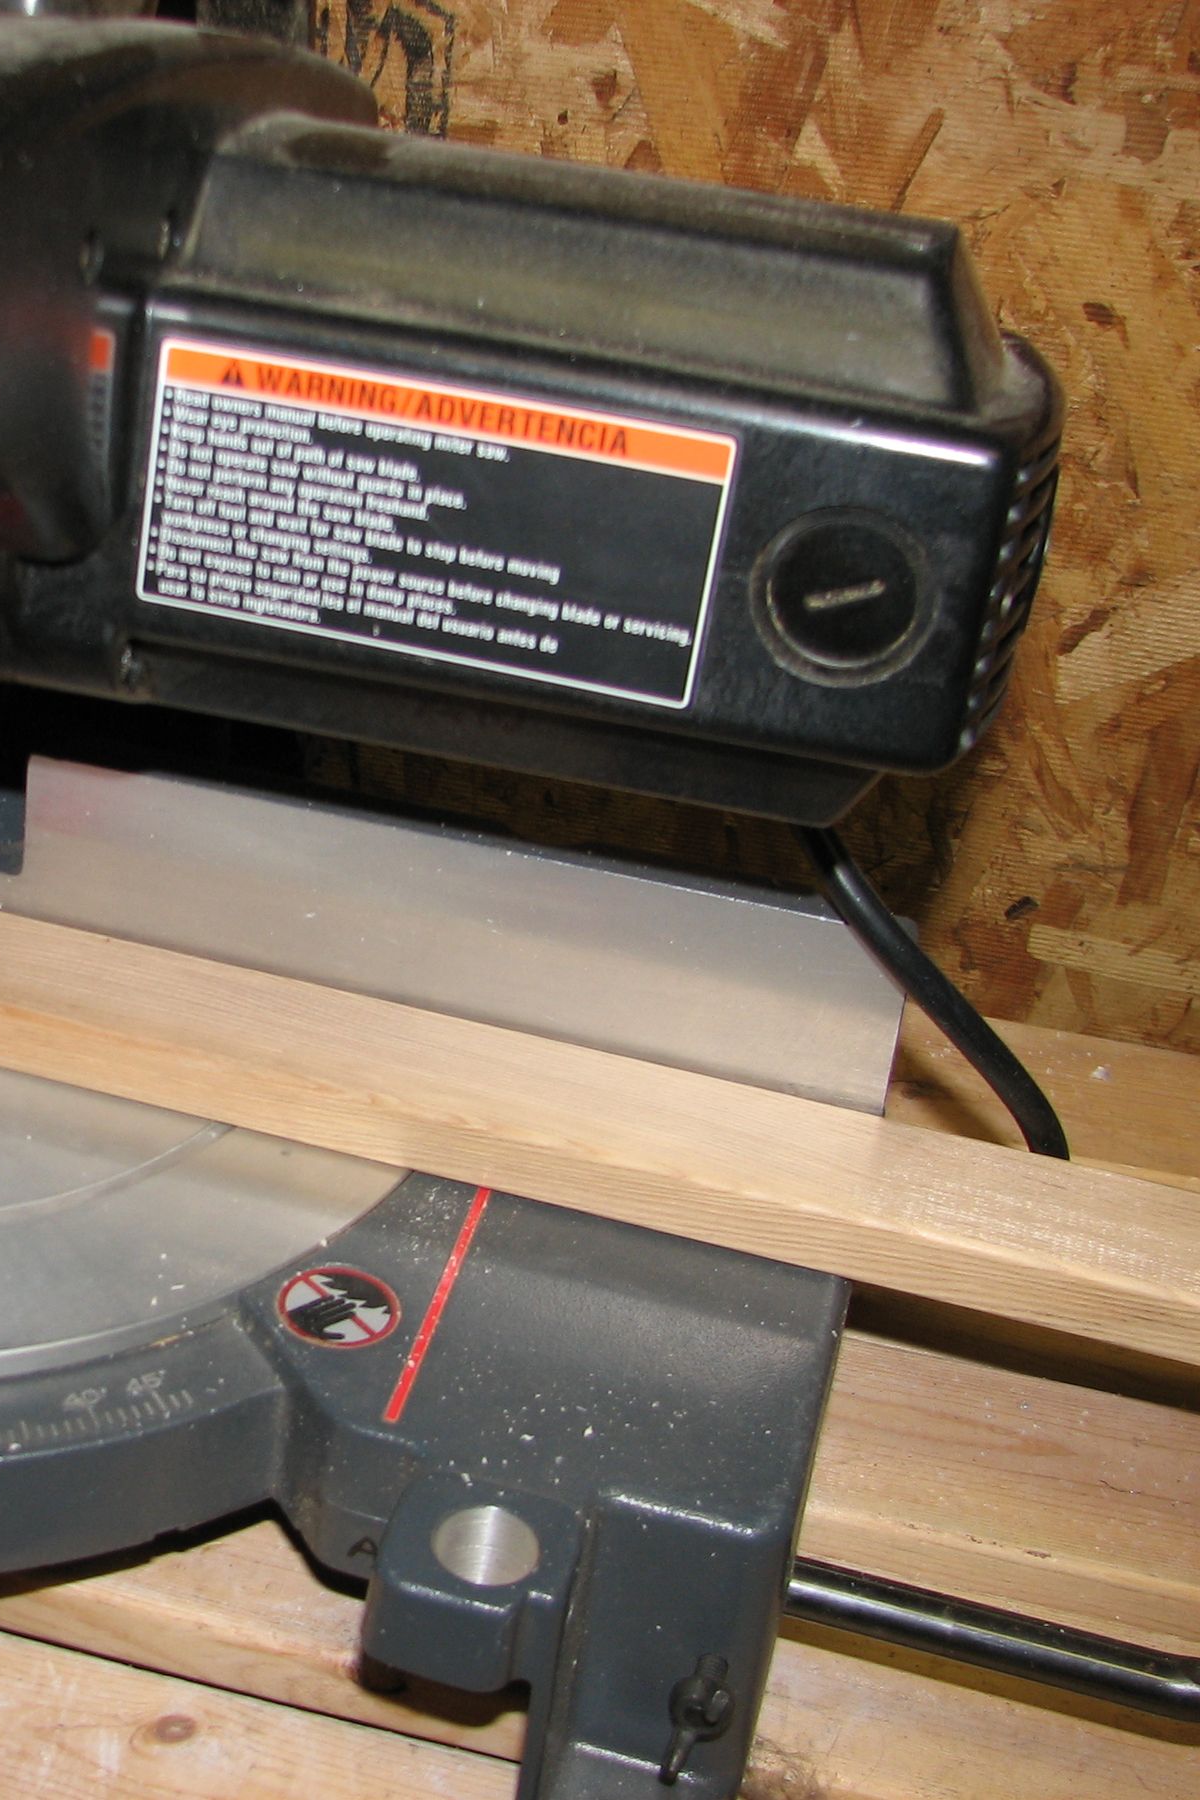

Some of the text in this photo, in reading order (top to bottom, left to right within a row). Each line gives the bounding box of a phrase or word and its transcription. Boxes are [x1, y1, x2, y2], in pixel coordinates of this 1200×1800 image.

[172, 405, 208, 426] Wear
[210, 414, 236, 433] eye
[173, 388, 208, 408] Read
[263, 404, 315, 427] manual
[317, 413, 362, 435] before
[364, 421, 432, 451] operating
[168, 438, 188, 459] Do
[189, 442, 213, 463] not
[214, 447, 268, 475] operate
[269, 459, 300, 479] saw
[301, 462, 355, 489] without
[356, 472, 404, 500] guards
[406, 481, 423, 501] in
[170, 421, 205, 446] Keep
[206, 428, 248, 451] hands
[249, 435, 274, 456] out
[275, 440, 292, 459] of
[292, 443, 326, 468] path
[327, 449, 344, 468] of
[345, 455, 375, 474] saw
[164, 474, 204, 497] Never
[247, 489, 295, 514] around
[296, 498, 320, 518] the
[321, 506, 352, 524] saw
[166, 456, 186, 476] Do
[187, 460, 211, 481] not
[268, 478, 296, 498] any
[296, 480, 363, 511] operation
[195, 497, 216, 517] off
[217, 501, 246, 523] tool
[248, 507, 274, 528] and
[274, 512, 308, 534] wait
[309, 518, 330, 539] for
[332, 525, 362, 545] saw
[363, 529, 404, 552] blade
[406, 536, 422, 556] to
[423, 540, 457, 565] stop
[458, 546, 504, 571] before
[506, 555, 561, 585] moving
[231, 525, 247, 540] or
[249, 526, 311, 555] changing
[157, 543, 177, 562] Do
[177, 546, 201, 566] not
[202, 554, 253, 578] expose
[255, 561, 271, 580] to
[271, 564, 301, 585] rain
[302, 573, 318, 589] or
[320, 576, 346, 594] use
[348, 579, 365, 598] in
[190, 584, 205, 601] la
[234, 540, 258, 560] the
[259, 547, 289, 567] saw
[291, 551, 324, 573] from
[326, 557, 350, 578] the
[351, 565, 395, 590] power
[397, 573, 445, 596] source
[446, 580, 493, 605] before
[494, 589, 559, 621] changing
[560, 601, 602, 625] blade
[603, 612, 620, 629] or
[622, 613, 694, 647] servicing.
[155, 560, 559, 653] Para su propia seguridad lea el manual del usuario antes de
